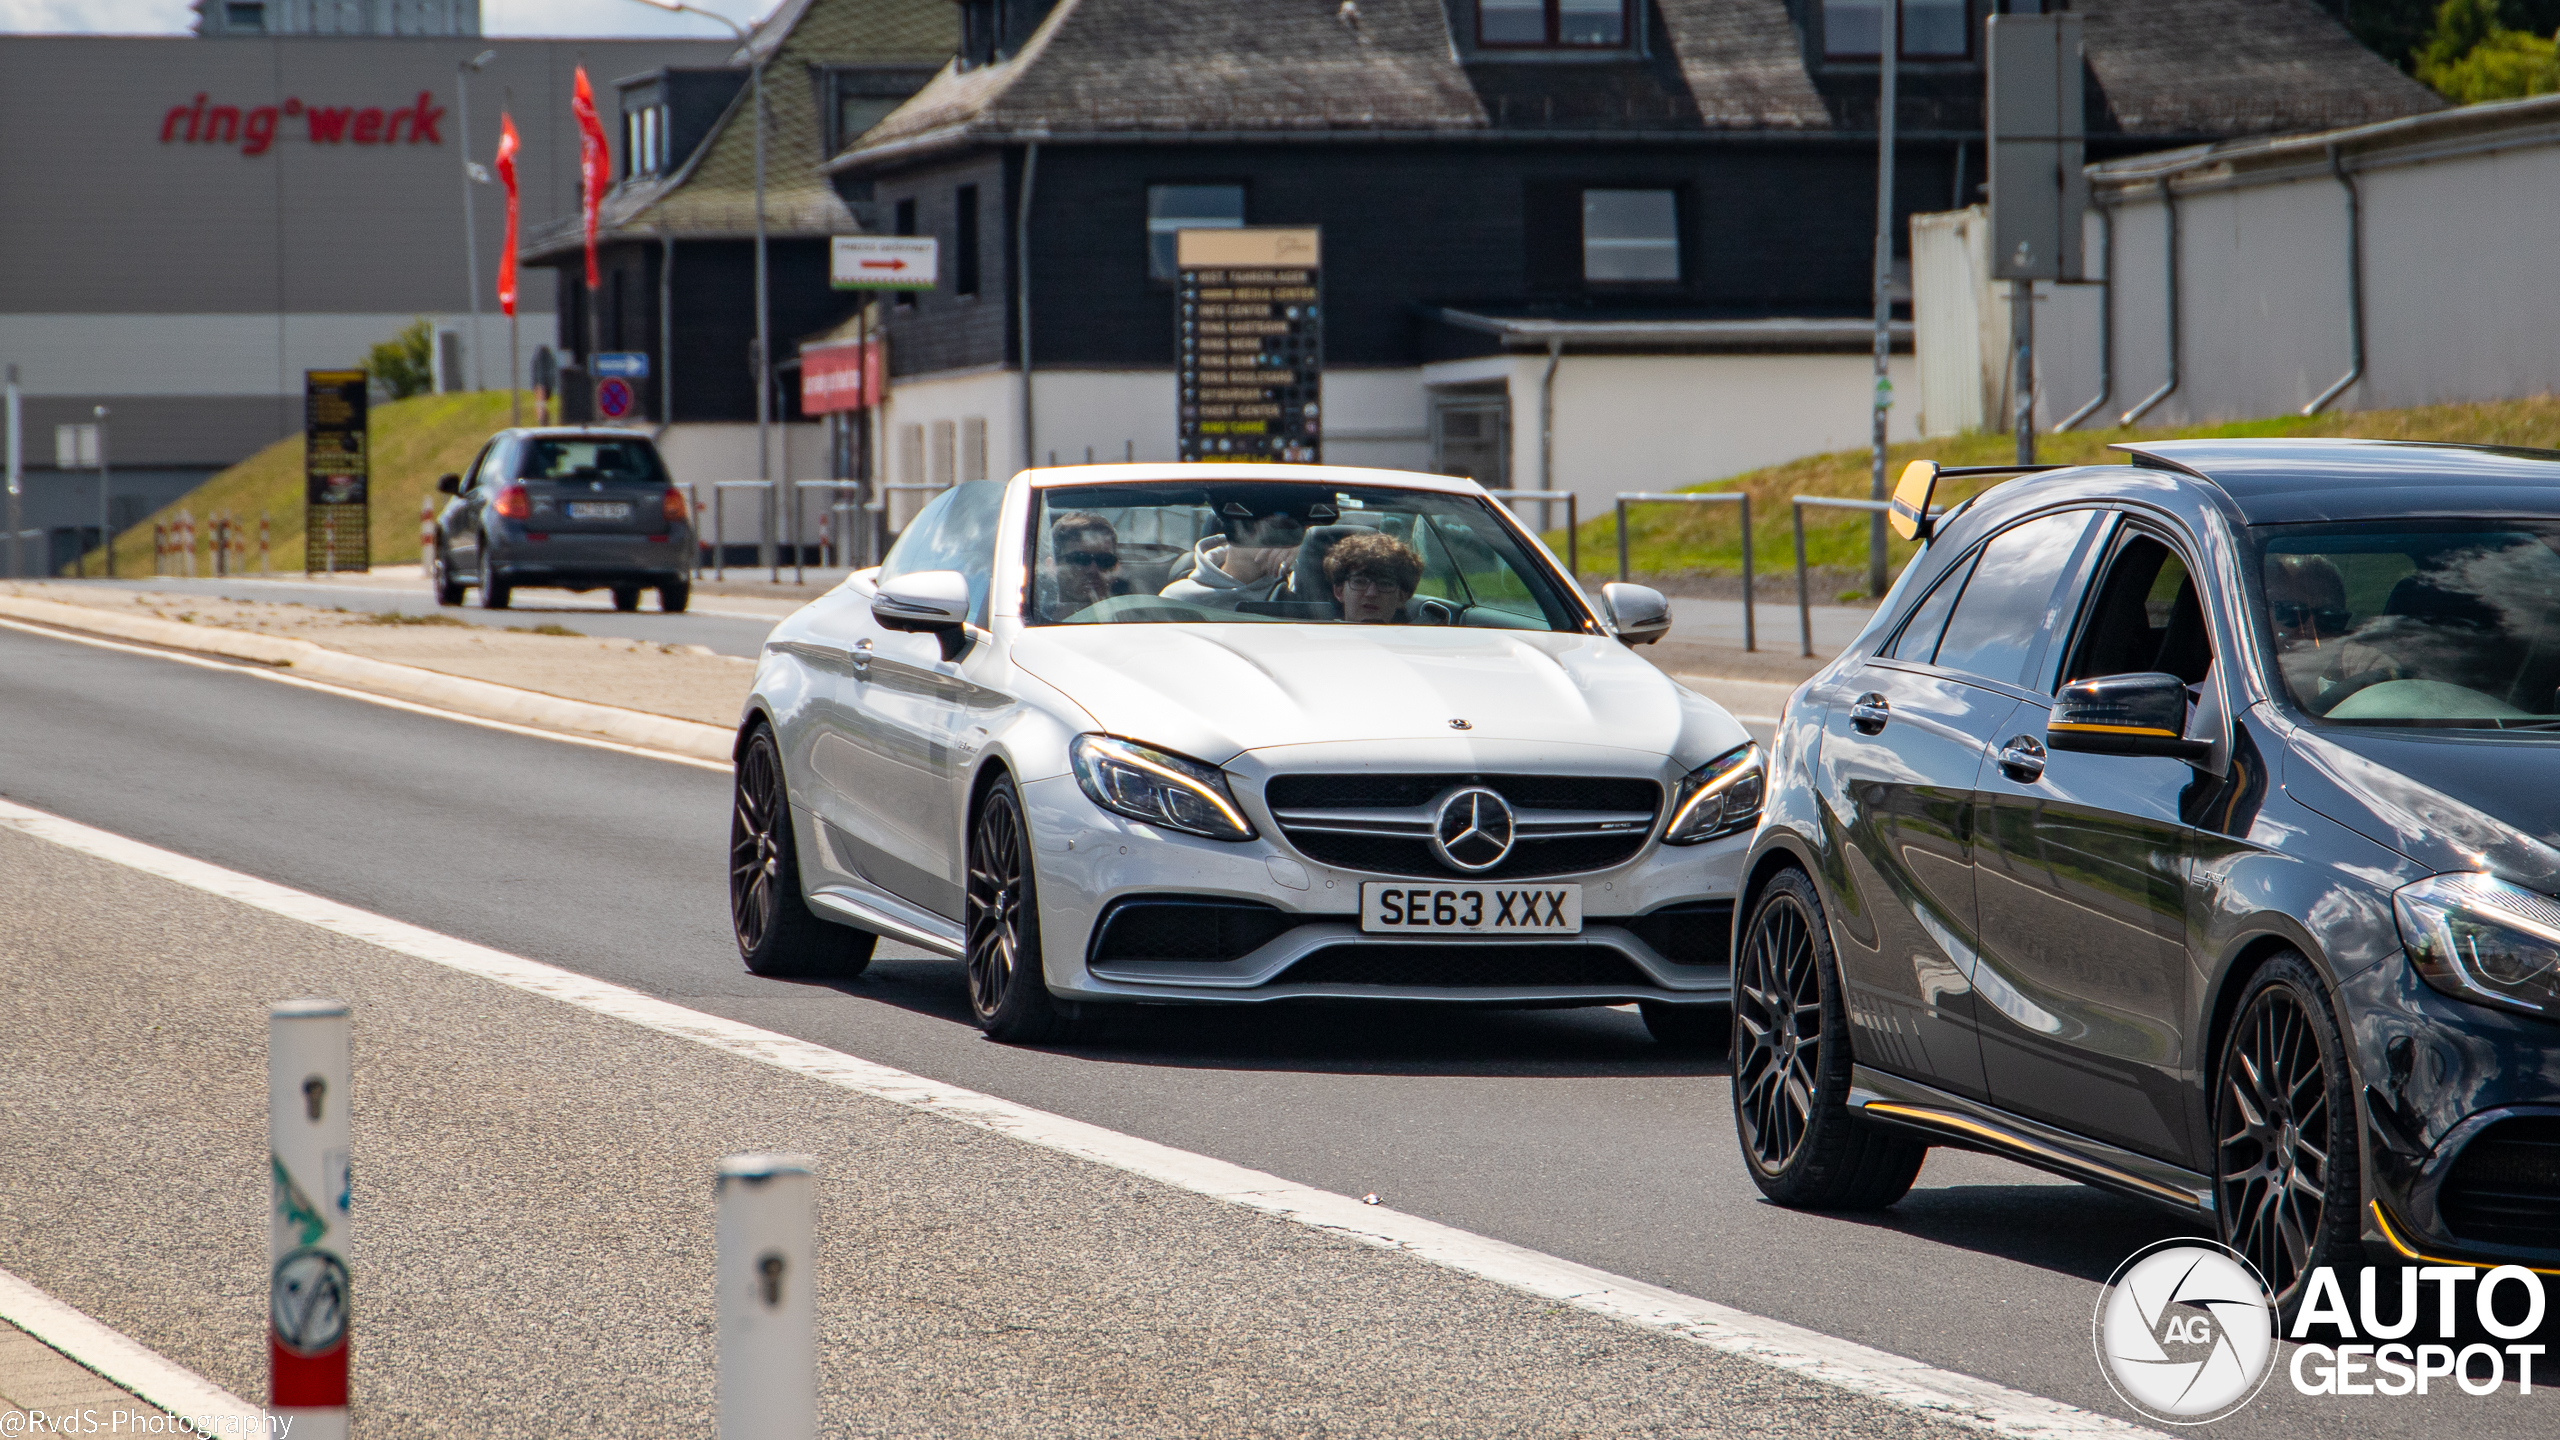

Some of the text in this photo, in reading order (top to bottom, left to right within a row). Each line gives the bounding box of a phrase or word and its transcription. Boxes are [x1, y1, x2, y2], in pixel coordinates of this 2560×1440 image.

[1274, 288, 1316, 300] CENTER
[1227, 304, 1271, 317] CENTER
[1199, 404, 1280, 417] EVENT CENTER
[1380, 889, 1567, 927] SE63 XXX
